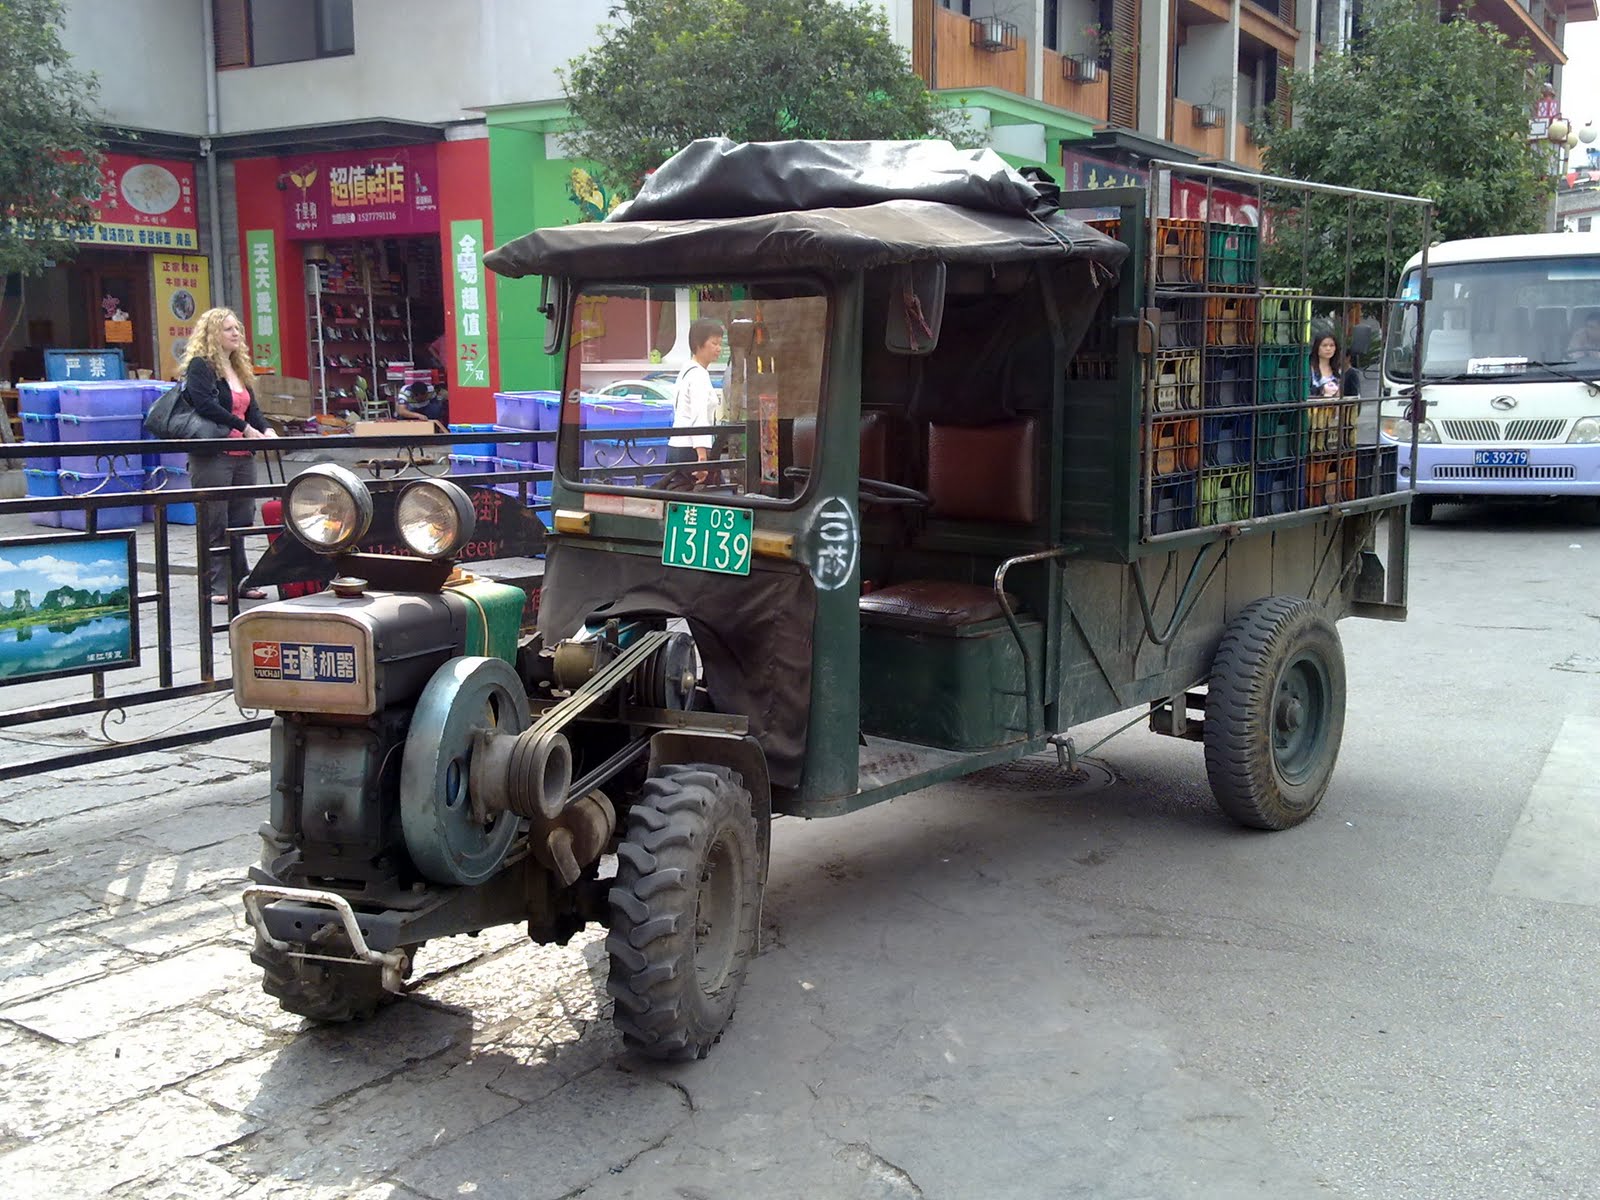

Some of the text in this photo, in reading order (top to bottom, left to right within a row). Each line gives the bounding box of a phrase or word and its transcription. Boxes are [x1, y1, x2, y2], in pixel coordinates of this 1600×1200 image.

[330, 162, 404, 207] 超值鞋店
[358, 212, 397, 222] 15277791116
[162, 261, 199, 273] 正宗桂林
[256, 343, 272, 359] 25
[460, 343, 478, 360] 25
[65, 357, 106, 377] 严禁
[1493, 451, 1527, 464] 39279
[684, 505, 735, 530] 桂 03
[669, 526, 749, 571] 13139
[283, 649, 354, 678] 玉机器
[254, 669, 280, 678] YUCHAI
